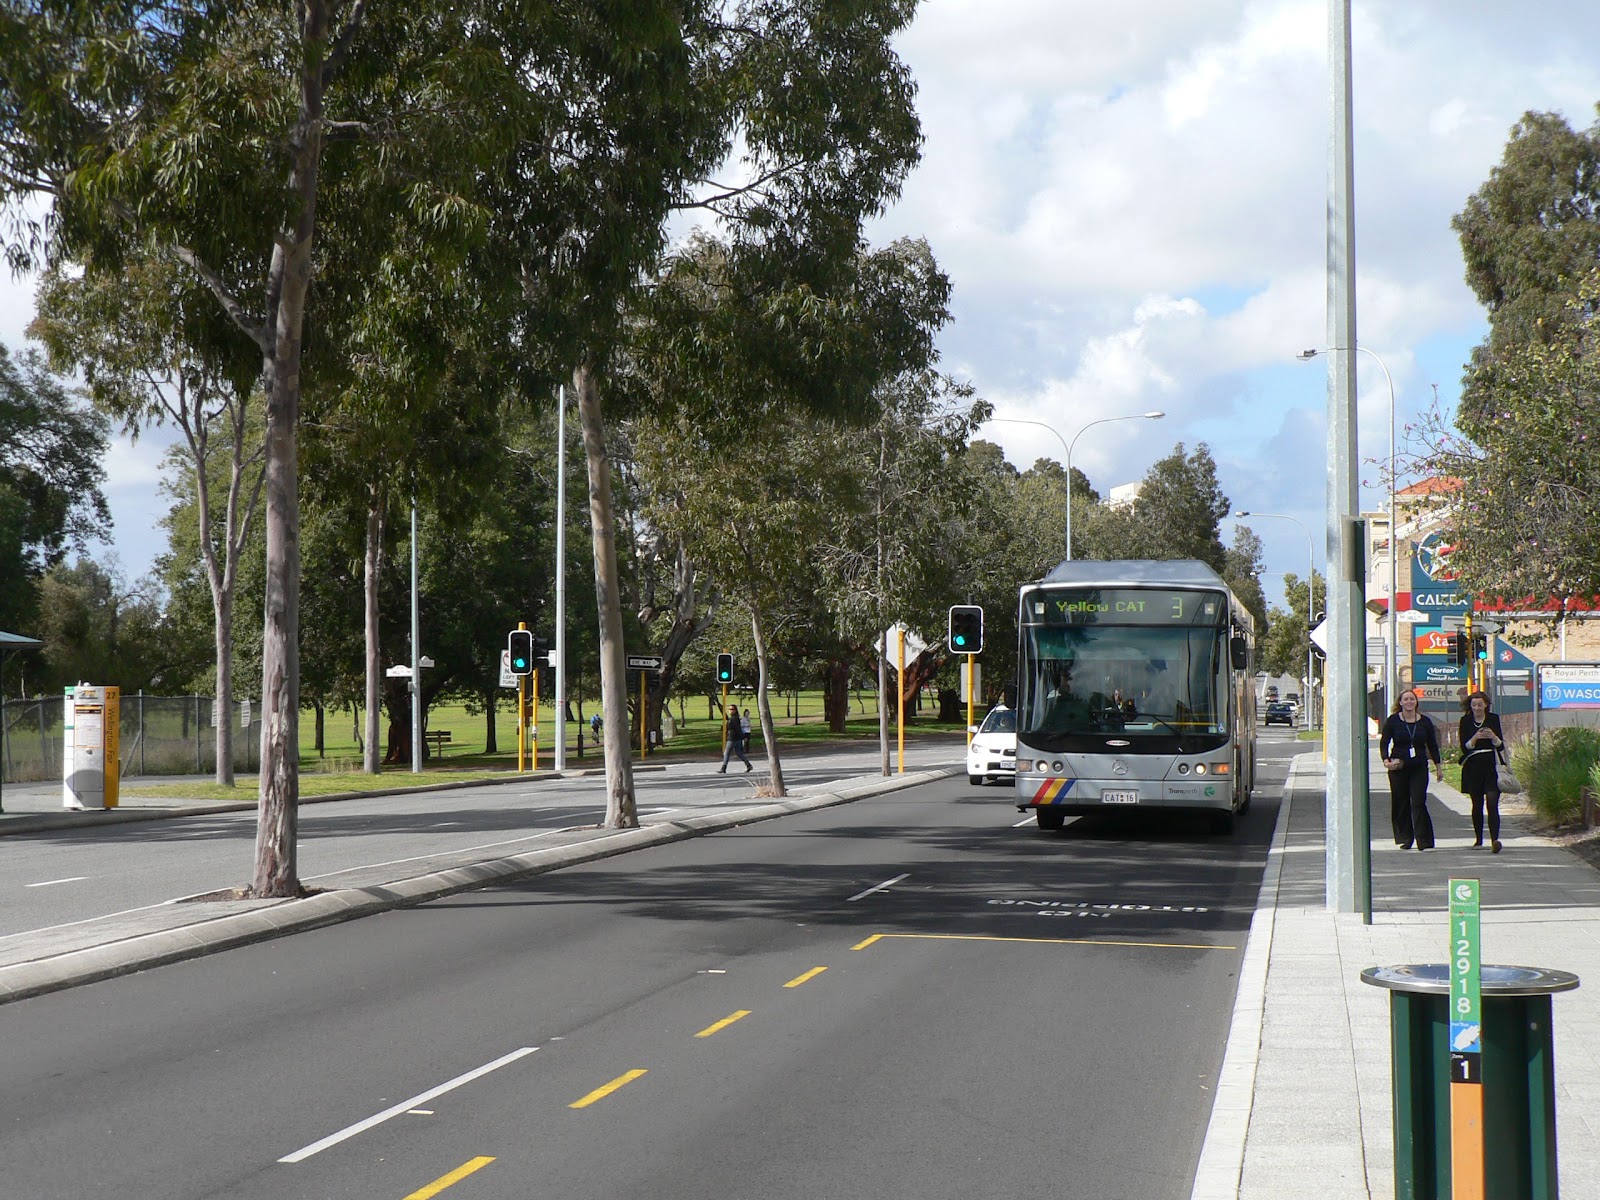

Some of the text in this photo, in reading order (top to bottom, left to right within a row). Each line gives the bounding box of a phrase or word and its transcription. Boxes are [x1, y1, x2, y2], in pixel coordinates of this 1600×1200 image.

[1055, 596, 1183, 619] Yellow CAT 3
[1554, 669, 1577, 677] Royal
[1547, 689, 1559, 698] 17
[1105, 794, 1134, 802] CAT 16
[1460, 1060, 1470, 1080] 1
